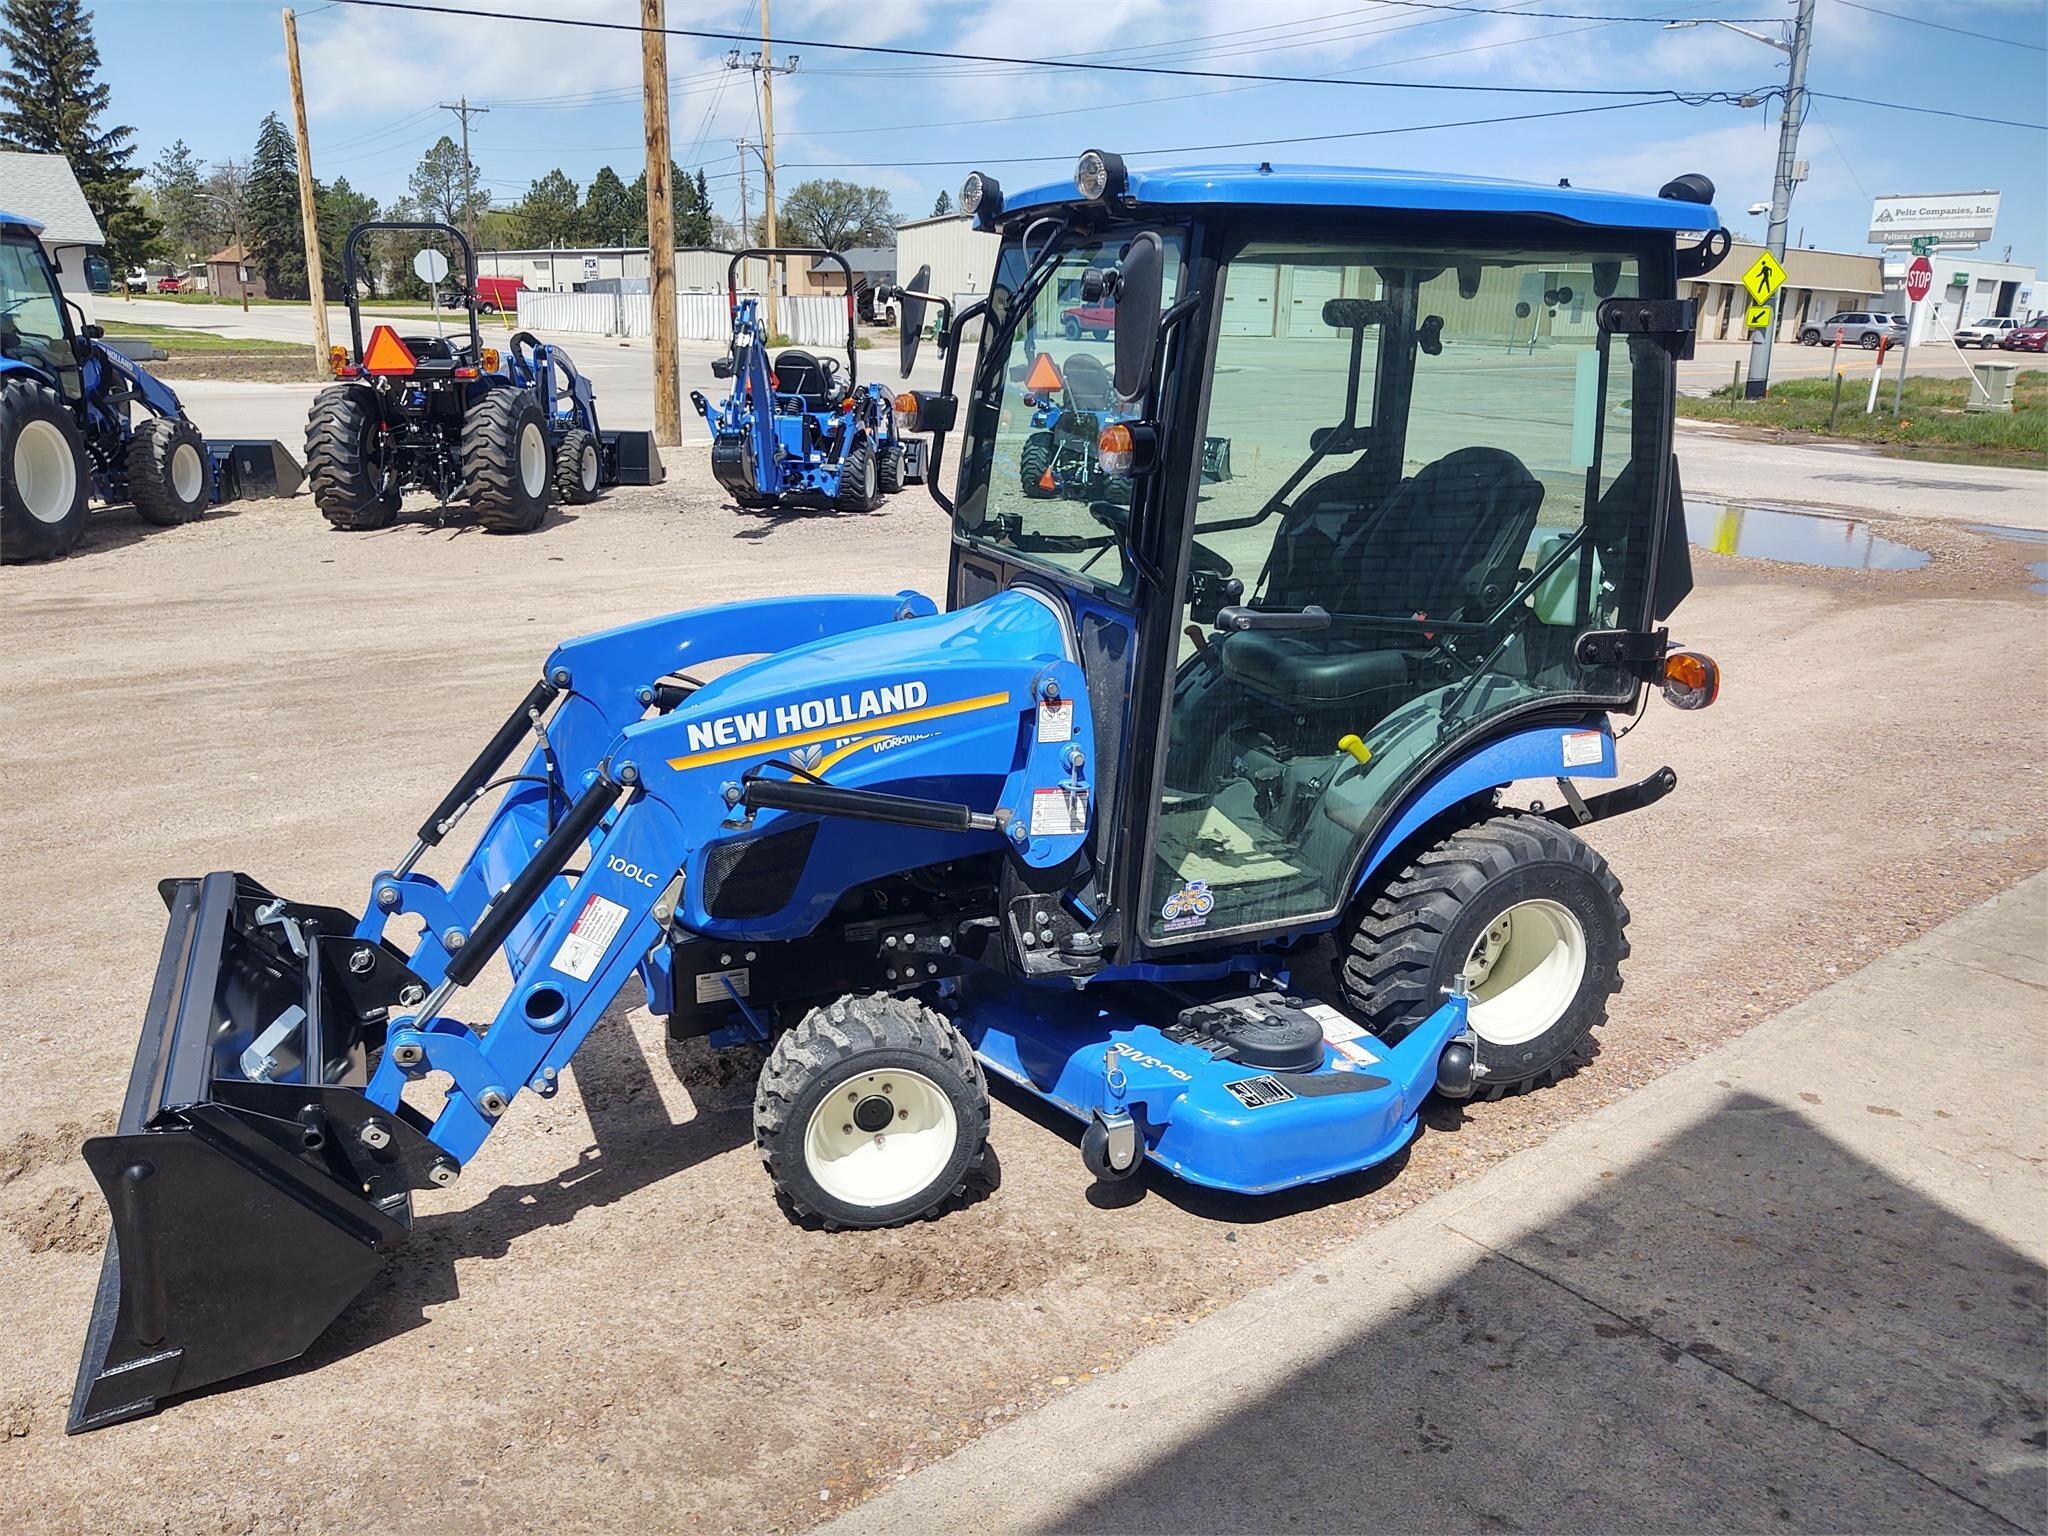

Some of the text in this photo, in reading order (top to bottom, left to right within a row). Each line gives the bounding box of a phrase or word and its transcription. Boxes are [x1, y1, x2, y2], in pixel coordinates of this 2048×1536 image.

[1895, 206, 1994, 217] Peltz Companies, Inc.
[1908, 270, 1930, 289] STOP
[687, 681, 928, 751] NEW HOLLAND
[607, 854, 659, 888] 100LC
